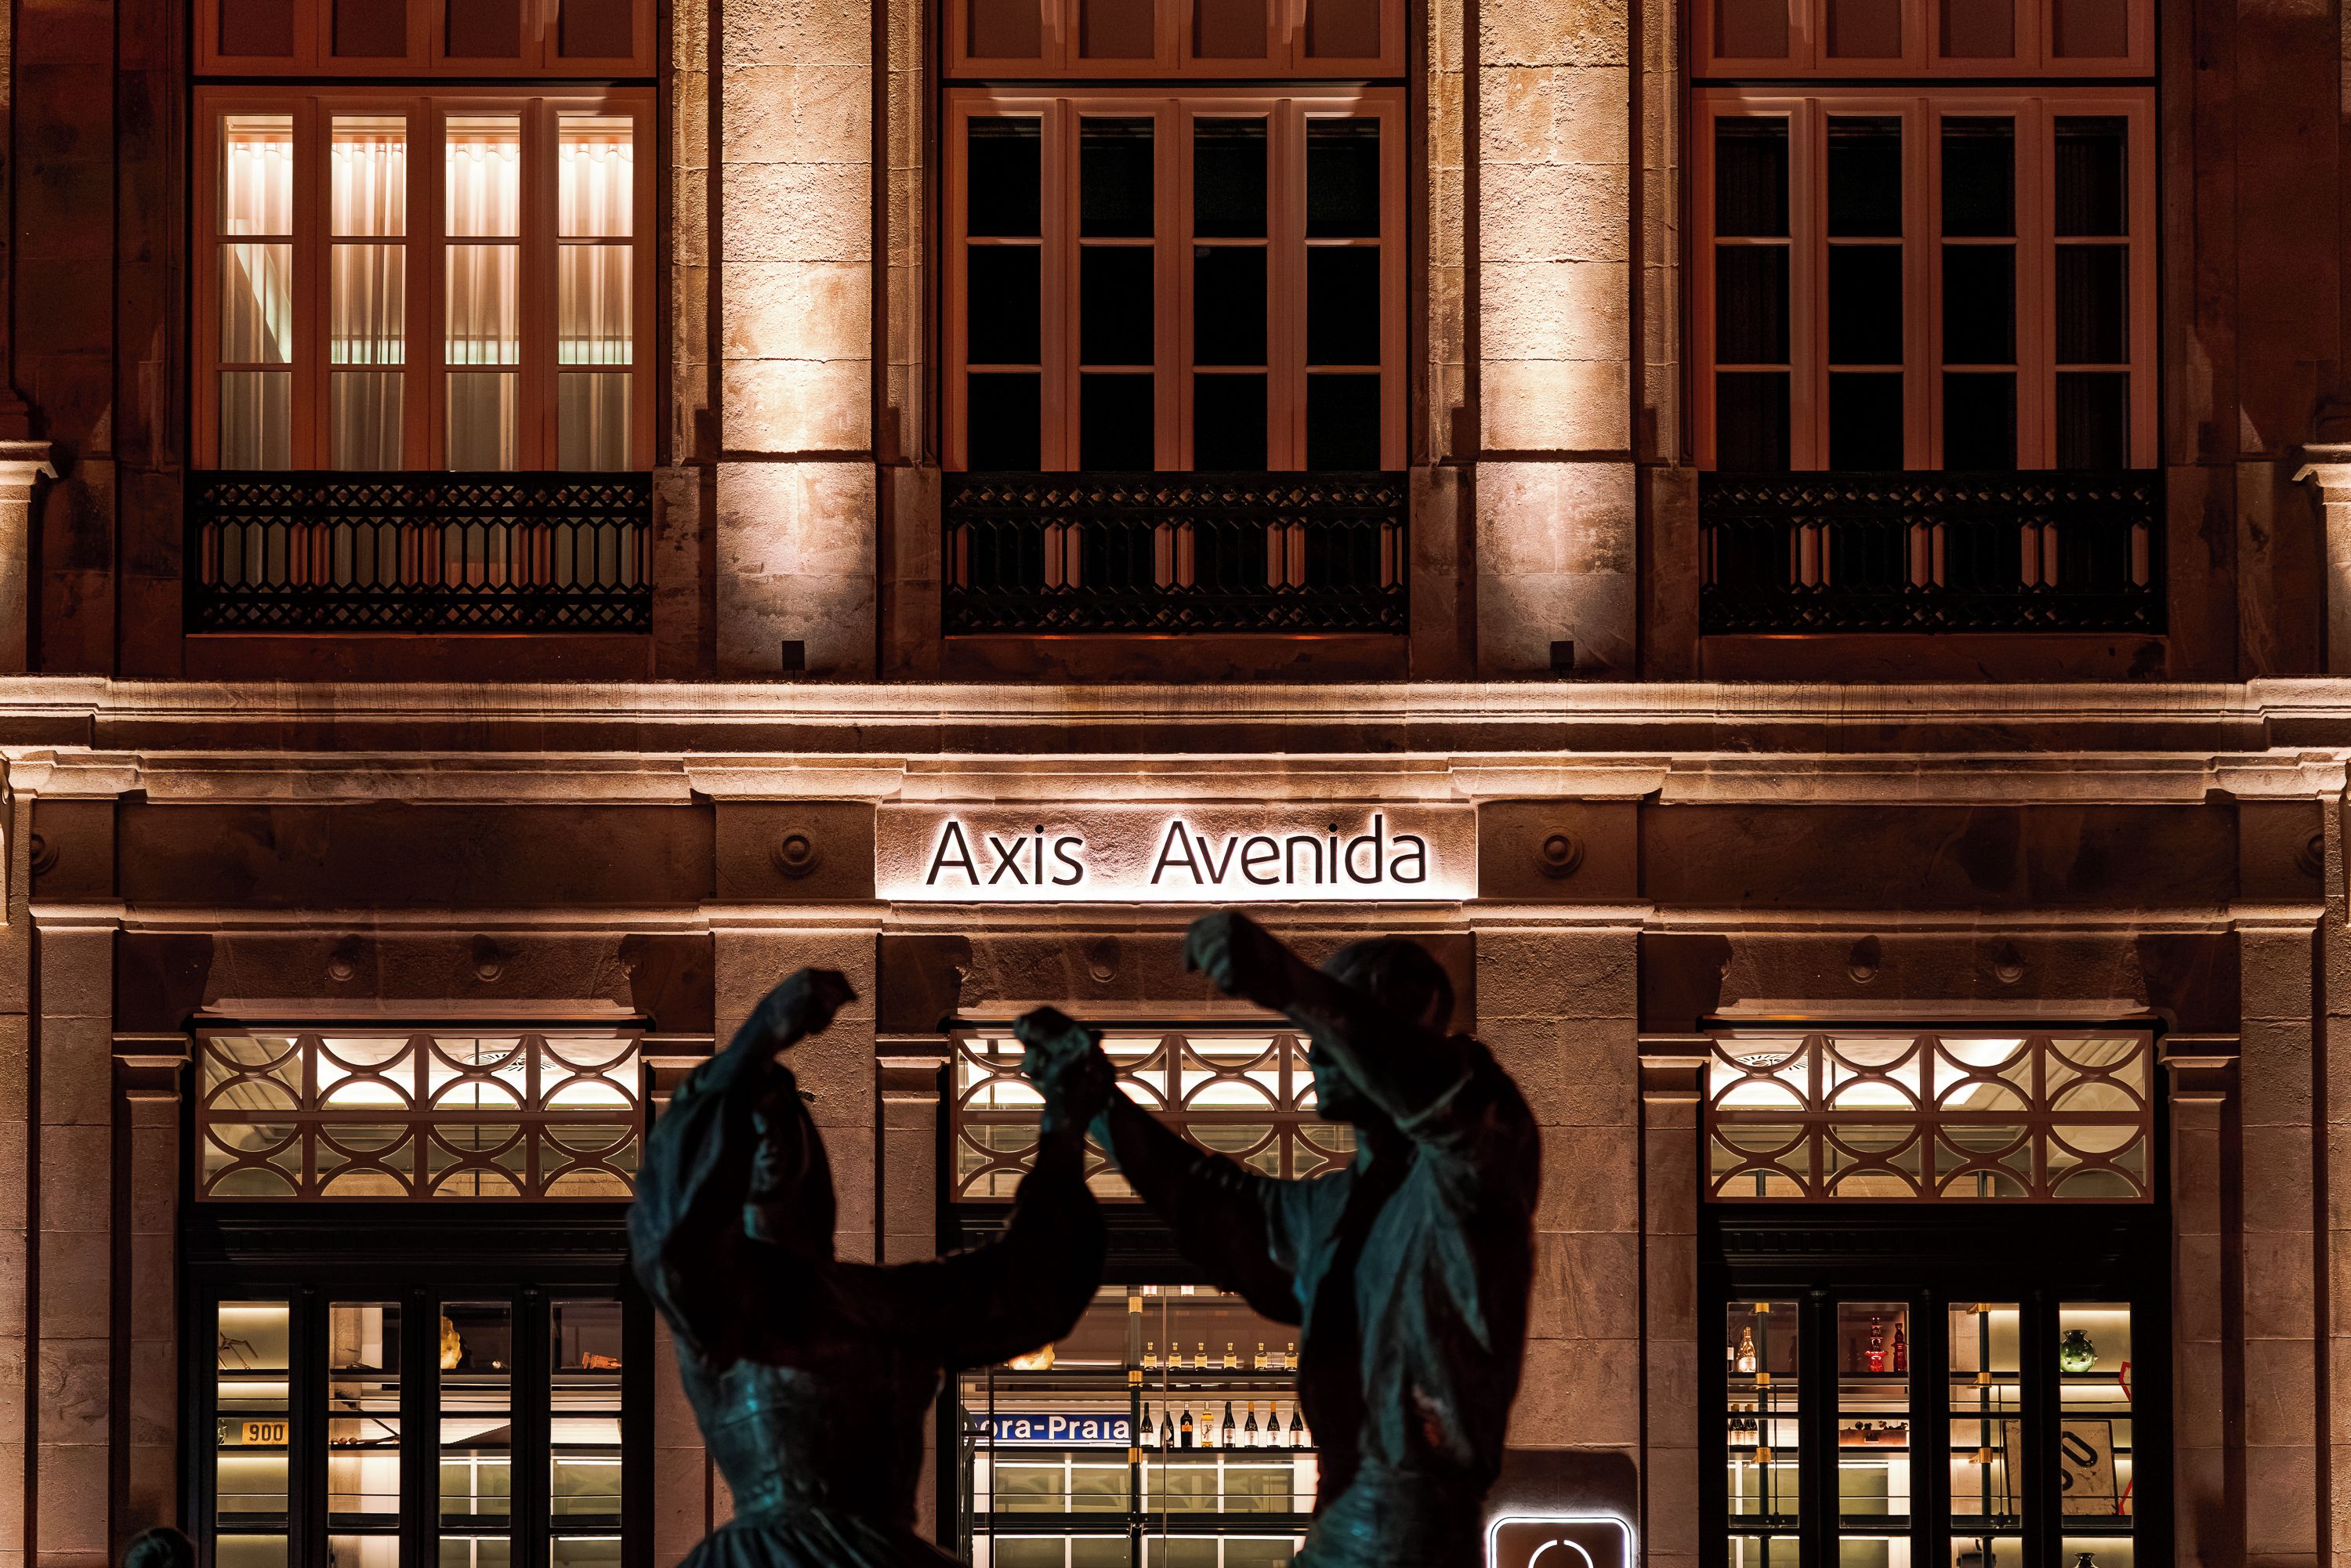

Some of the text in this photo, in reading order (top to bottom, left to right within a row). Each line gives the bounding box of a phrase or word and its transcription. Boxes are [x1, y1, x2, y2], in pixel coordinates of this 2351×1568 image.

[926, 814, 1426, 885] Axis Avenida
[249, 1424, 284, 1442] 900
[963, 1416, 1130, 1439] ora-Praia
